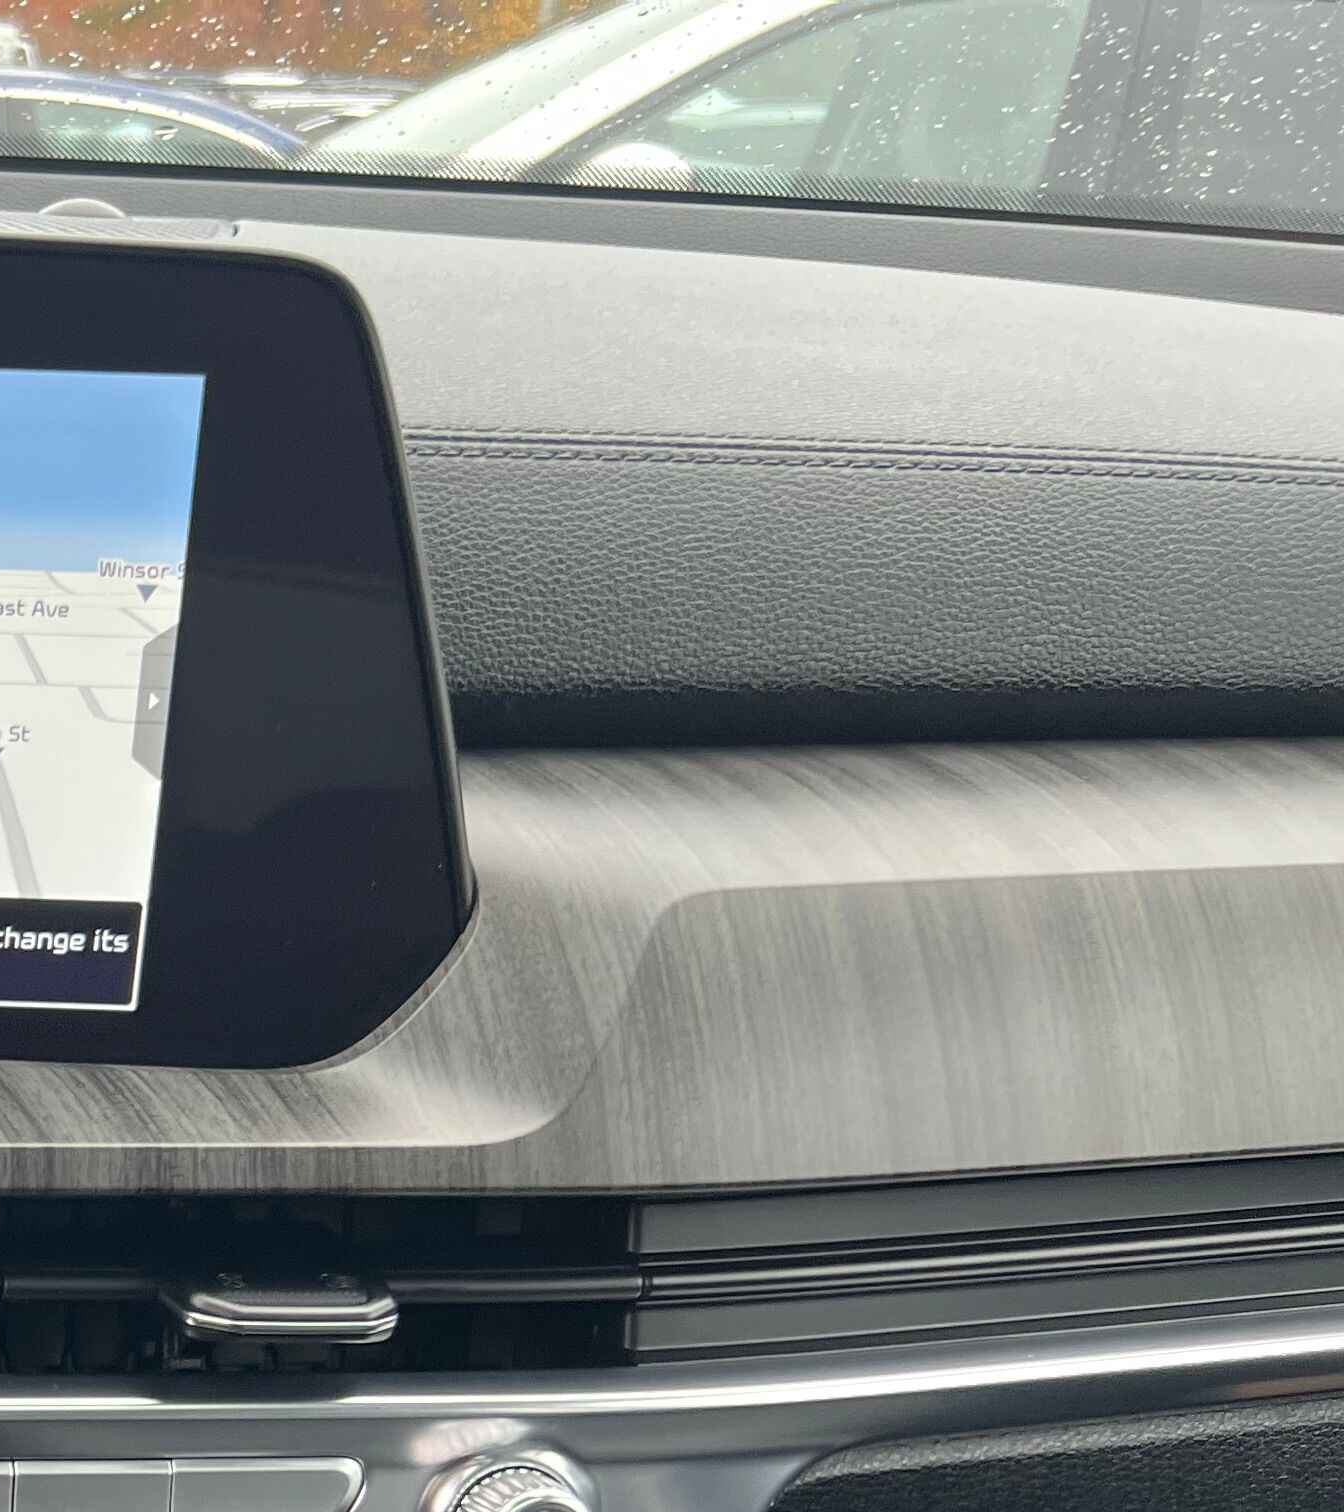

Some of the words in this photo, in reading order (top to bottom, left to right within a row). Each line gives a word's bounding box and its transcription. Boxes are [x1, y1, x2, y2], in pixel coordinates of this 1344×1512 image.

[98, 559, 171, 579] Winsor
[32, 600, 70, 618] Ave
[9, 724, 31, 744] St
[92, 928, 130, 953] its
